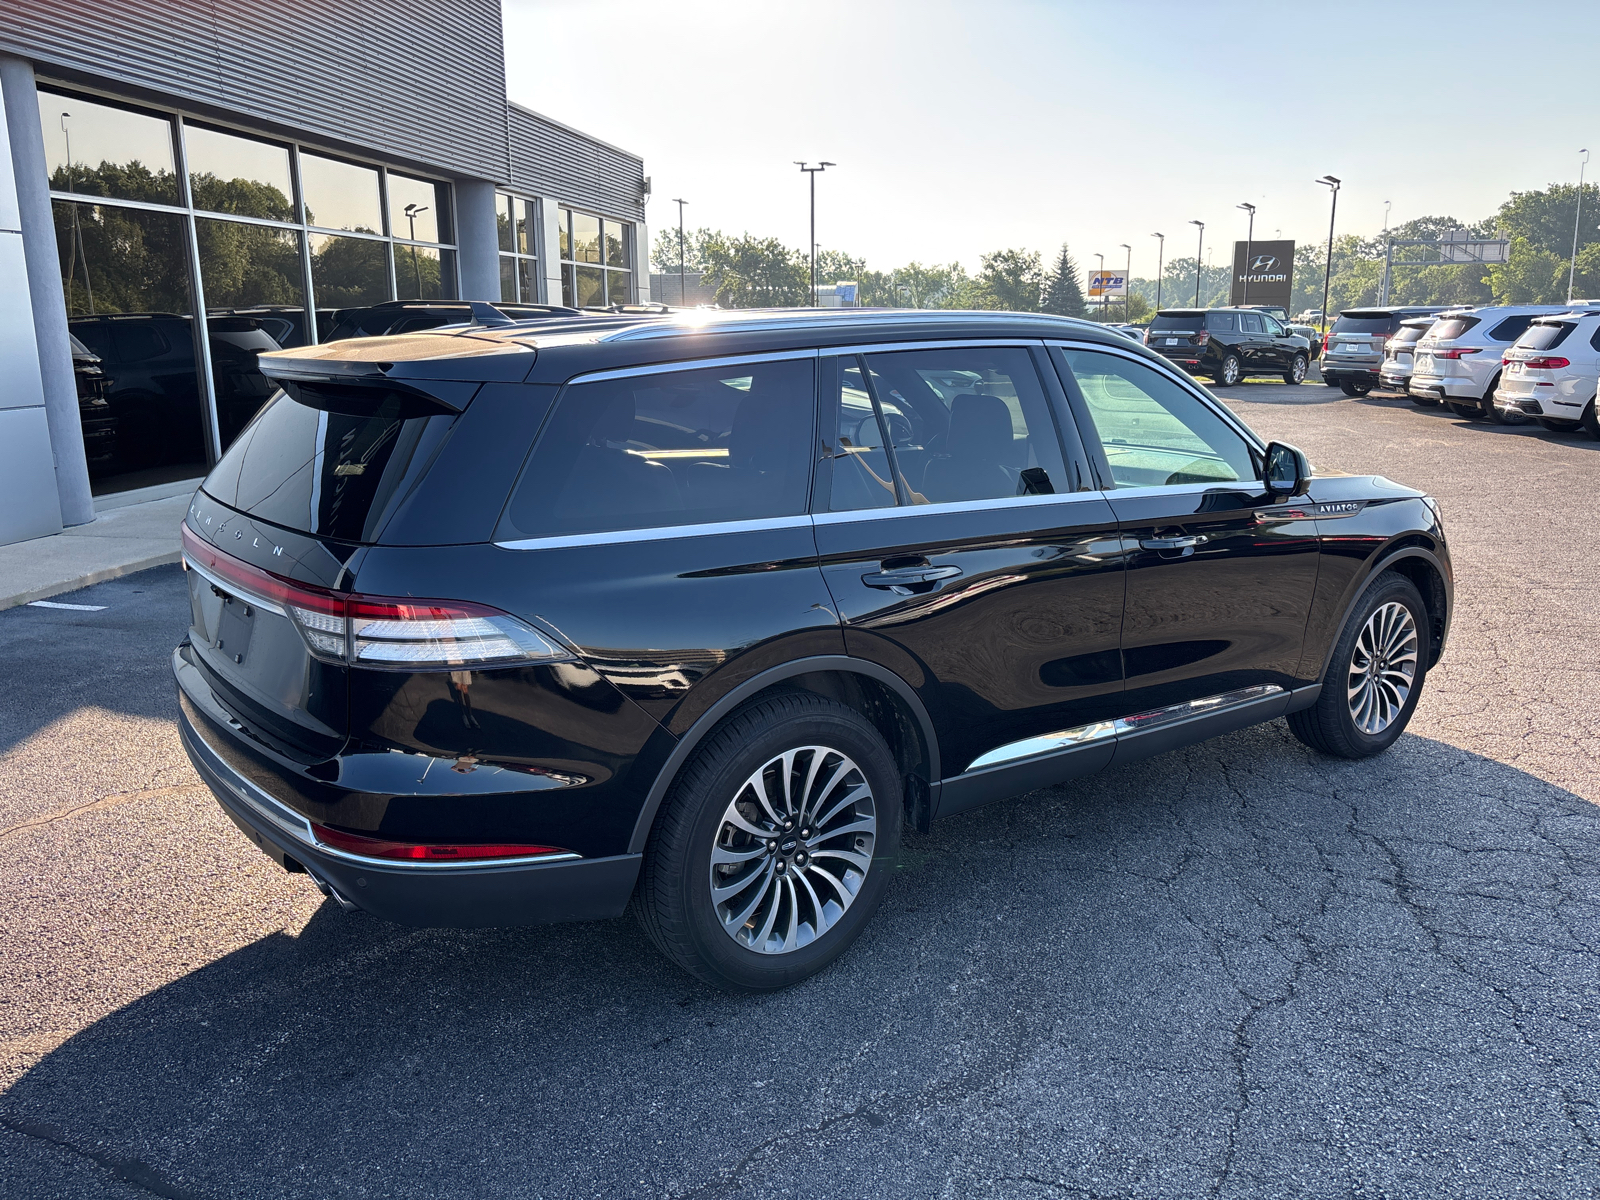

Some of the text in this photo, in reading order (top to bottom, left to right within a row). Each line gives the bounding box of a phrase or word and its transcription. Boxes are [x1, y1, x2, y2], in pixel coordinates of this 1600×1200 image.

[1093, 277, 1124, 285] NTB
[1239, 274, 1287, 283] HYUNDAI
[1320, 503, 1358, 512] AVIATOR
[190, 504, 283, 557] LINCOLN
